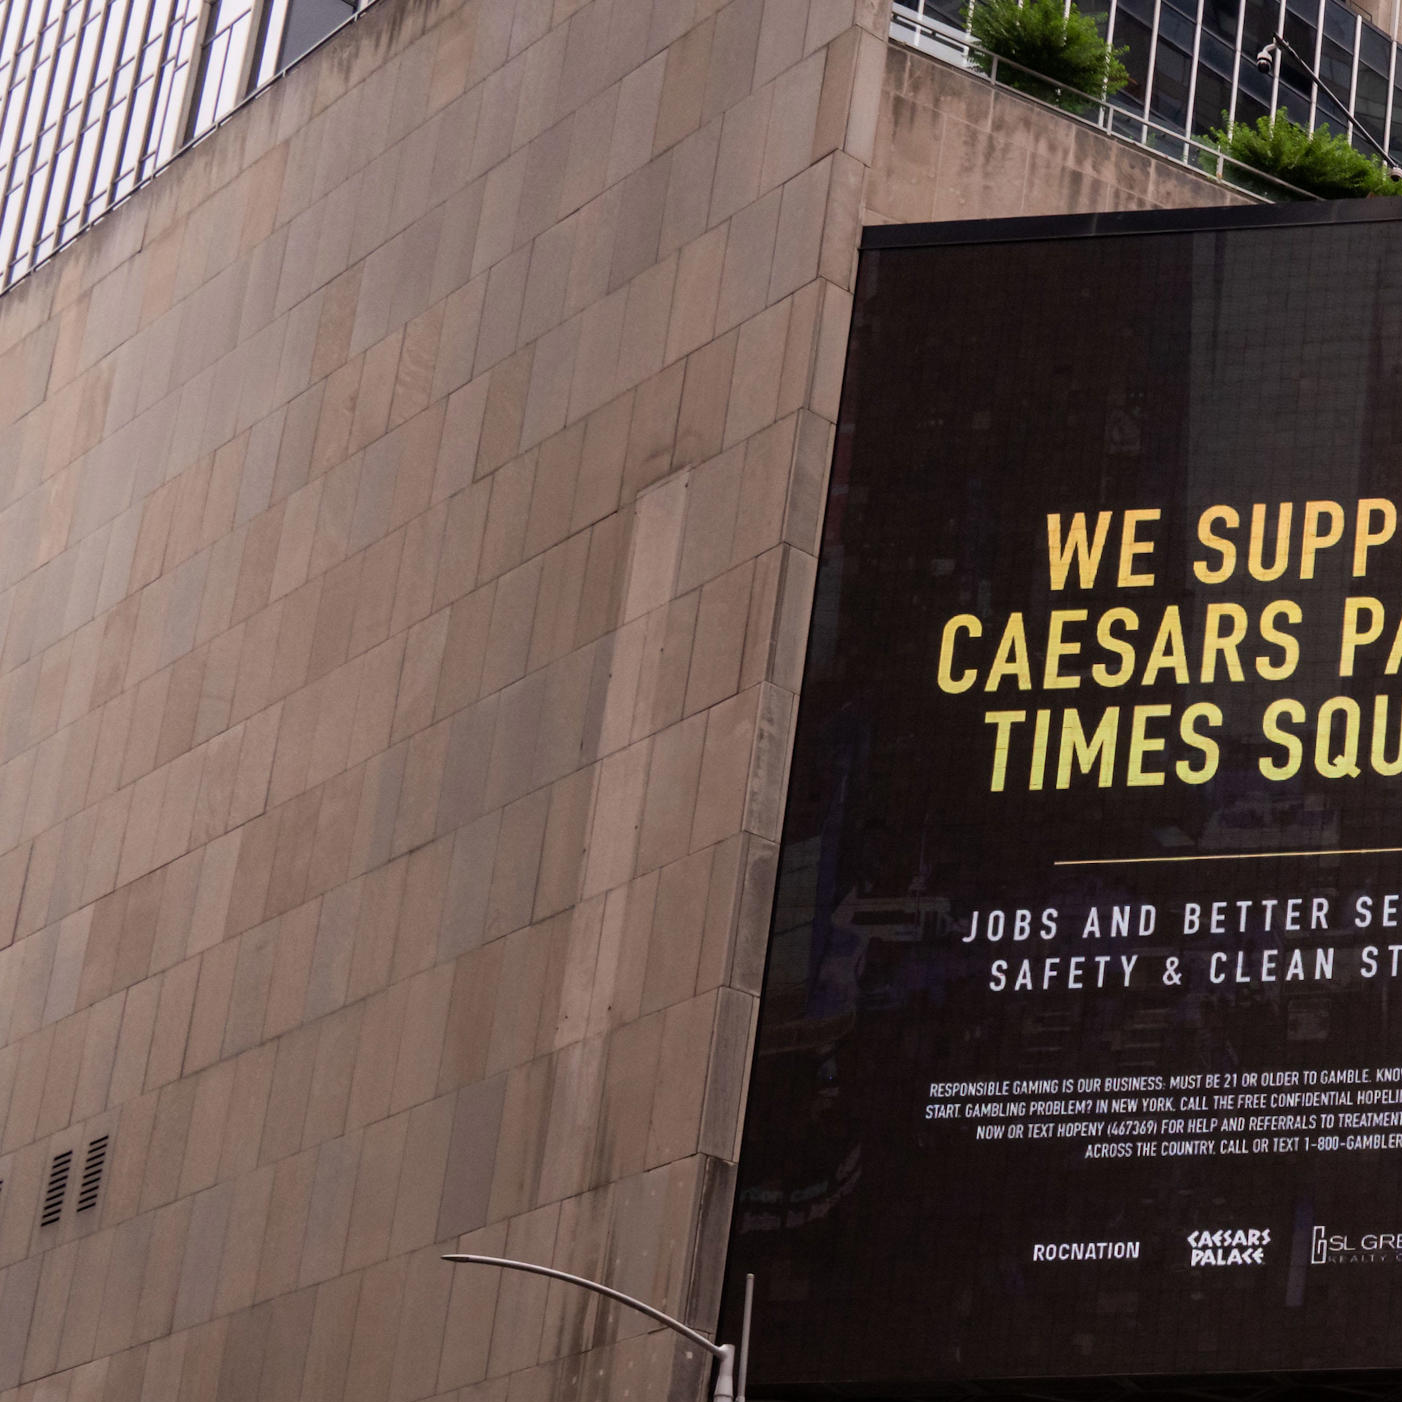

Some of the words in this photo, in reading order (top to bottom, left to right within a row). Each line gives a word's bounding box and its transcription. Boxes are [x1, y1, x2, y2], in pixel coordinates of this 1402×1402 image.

[1046, 508, 1160, 591] WE
[936, 598, 1303, 695] CAESARS
[983, 702, 1224, 792] TIMES
[961, 907, 1059, 943] JOBS
[1082, 903, 1158, 940] AND
[1183, 897, 1330, 937] BETTER
[989, 953, 1138, 992] SAFETY
[1161, 956, 1184, 987] &
[1208, 947, 1335, 985] CLEAN
[929, 1081, 1010, 1097] RESPONSIBLE
[1012, 1079, 1059, 1095] GAMING
[1062, 1078, 1074, 1093] IS
[1077, 1078, 1102, 1093] OUR
[1169, 1074, 1203, 1090] MUST
[1205, 1073, 1221, 1089] BE
[1223, 1073, 1237, 1088] 21
[1241, 1072, 1258, 1088] OR
[1260, 1071, 1299, 1087] OLDER
[1303, 1070, 1318, 1085] TO
[1032, 1241, 1140, 1262] ROCNATION
[1187, 1228, 1271, 1248] CAESARS
[1329, 1234, 1356, 1252] SL
[1190, 1247, 1266, 1267] PALACE
